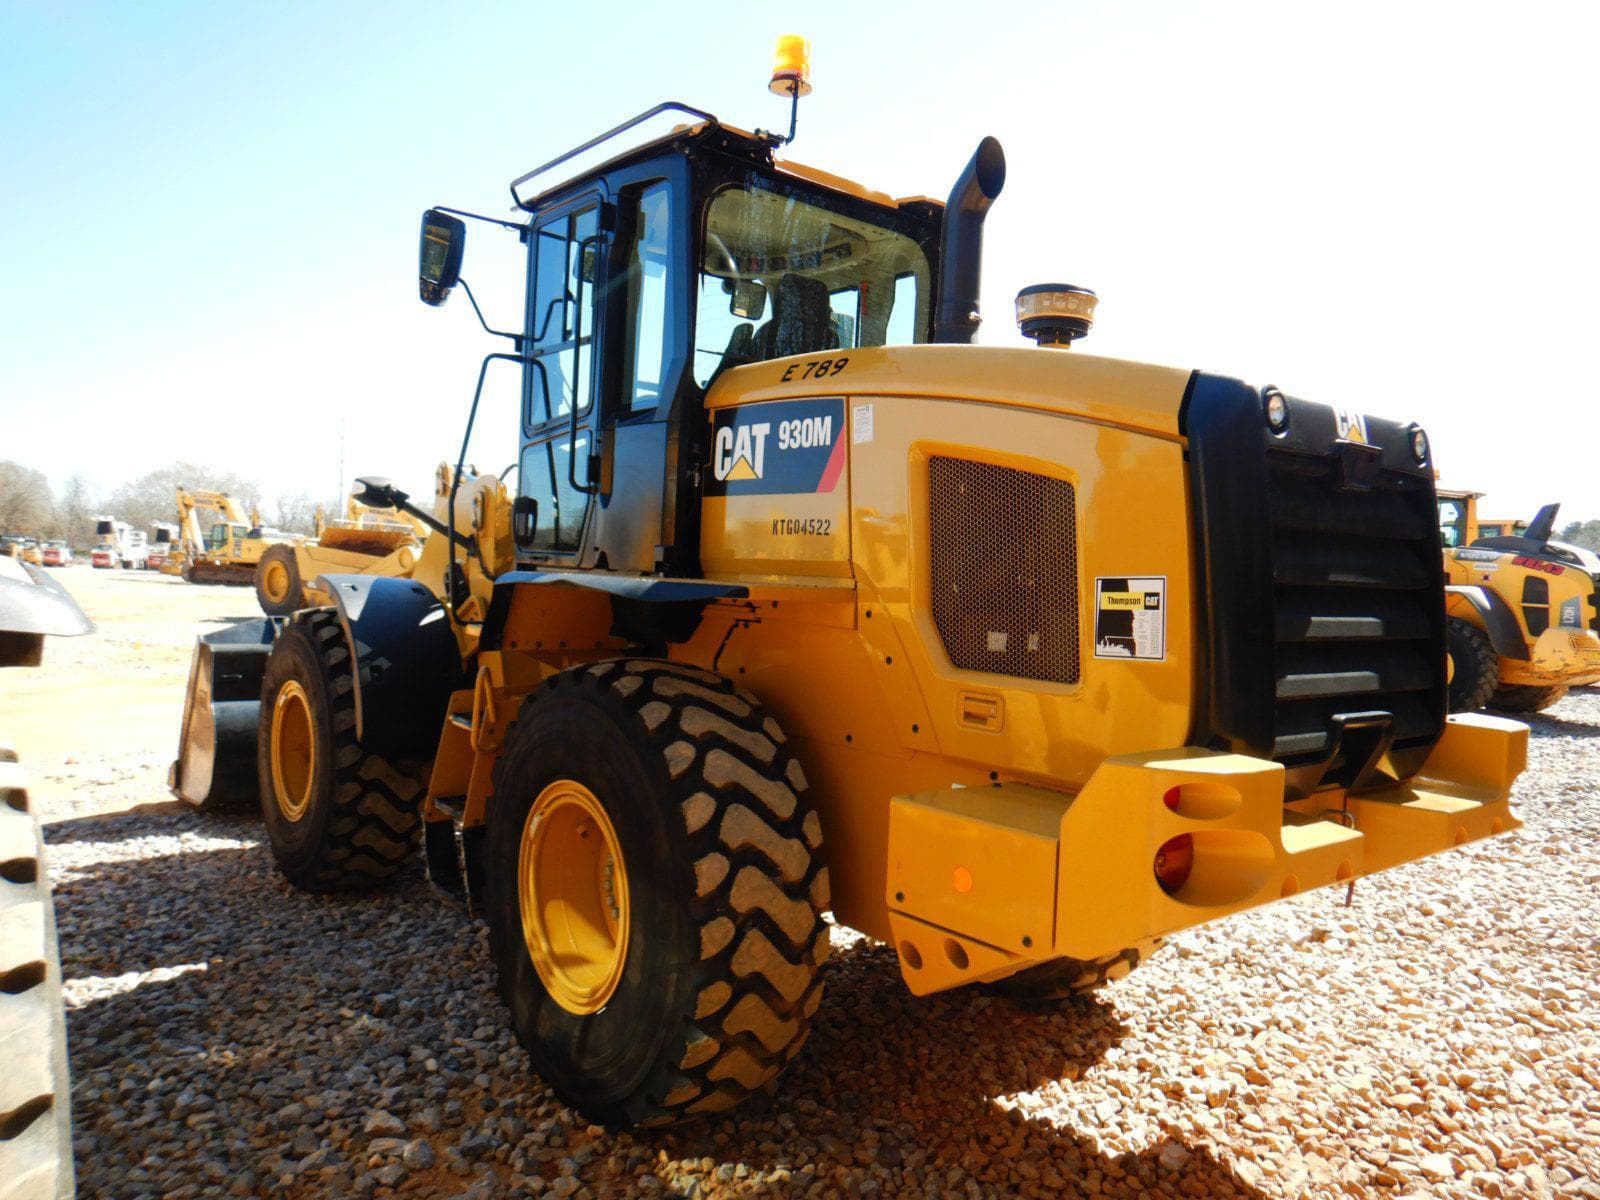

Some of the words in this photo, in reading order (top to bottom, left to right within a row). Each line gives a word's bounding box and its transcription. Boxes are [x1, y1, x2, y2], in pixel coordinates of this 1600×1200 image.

[780, 364, 800, 383] E
[802, 357, 850, 380] 789
[714, 422, 771, 481] CAT
[778, 415, 832, 450] 930M
[772, 518, 831, 536] KTG04522
[1107, 596, 1141, 606] Thompson
